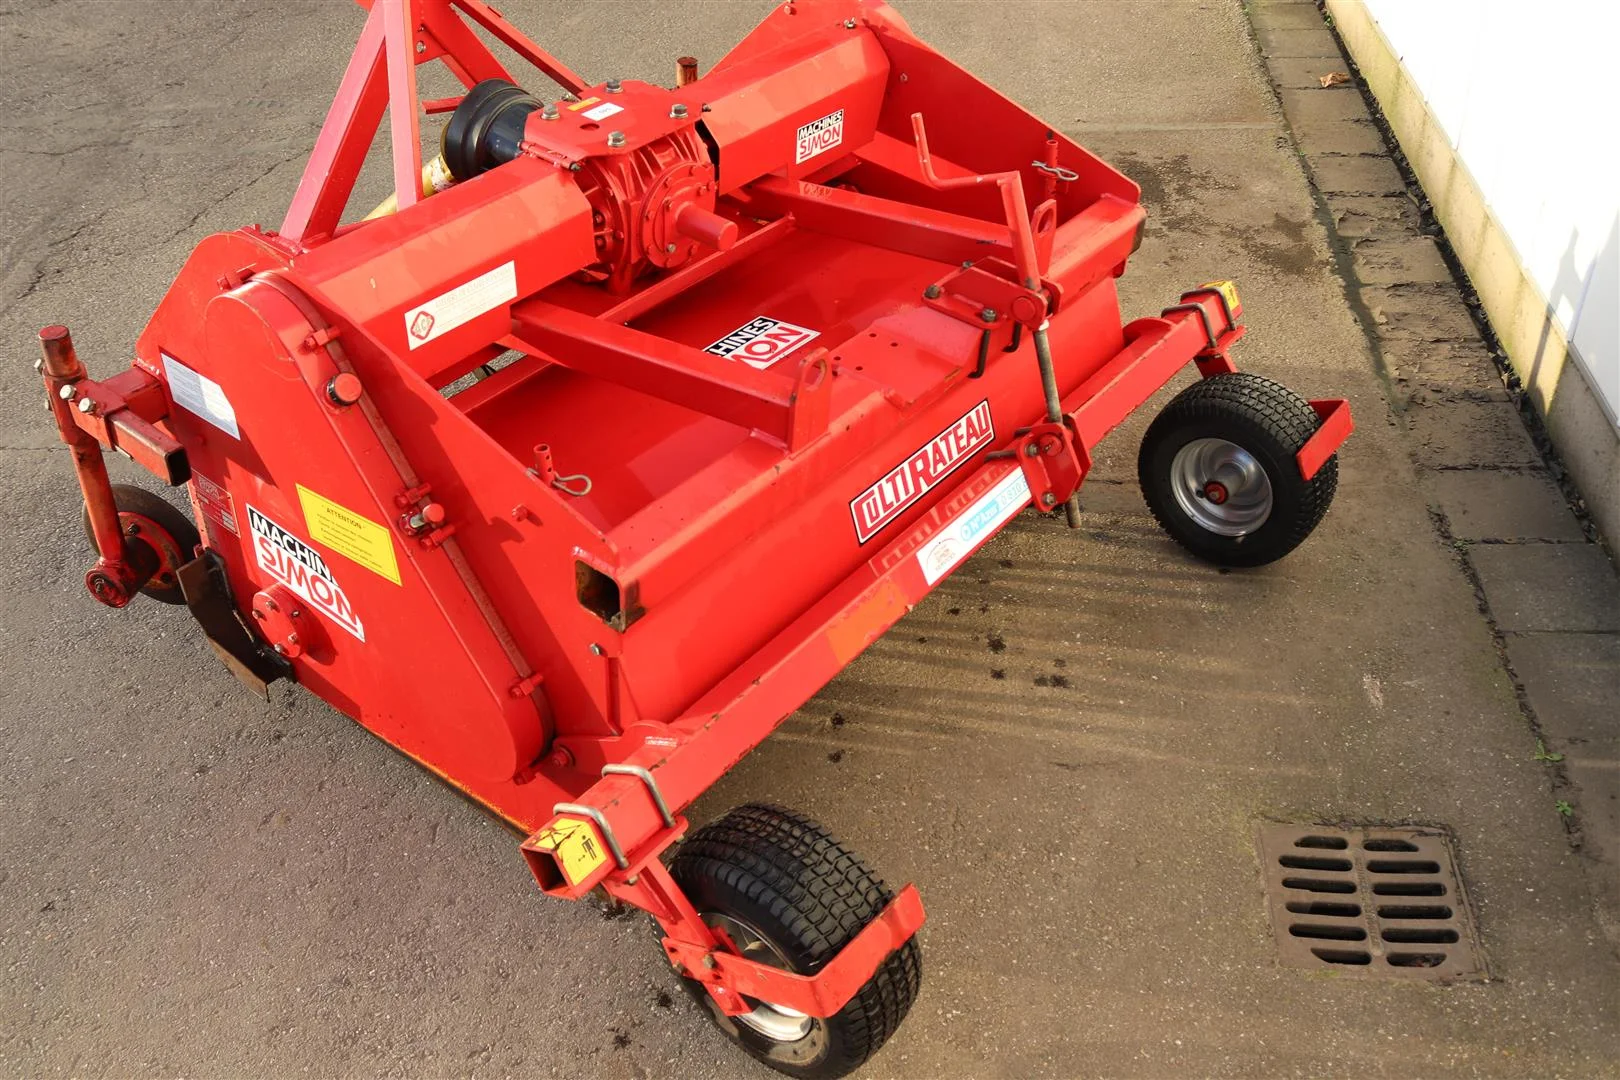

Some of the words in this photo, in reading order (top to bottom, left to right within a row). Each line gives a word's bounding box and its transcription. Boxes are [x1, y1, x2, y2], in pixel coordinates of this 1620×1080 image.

[799, 124, 840, 159] SIMON
[800, 110, 842, 140] MACHINES
[706, 319, 775, 356] HINES
[252, 511, 335, 584] MACHIN
